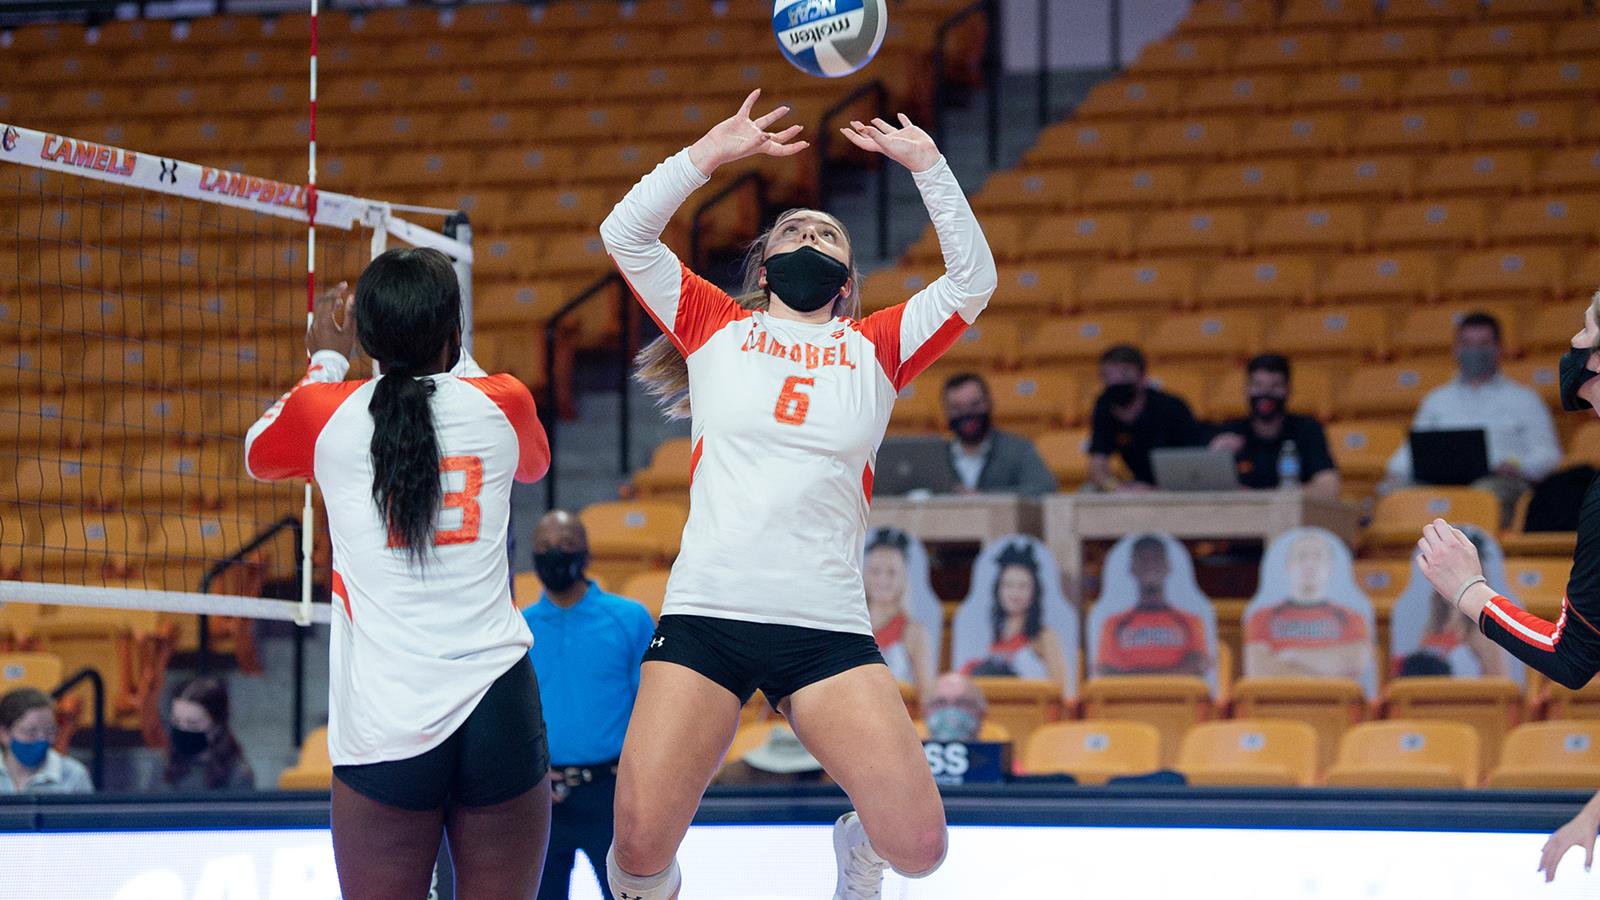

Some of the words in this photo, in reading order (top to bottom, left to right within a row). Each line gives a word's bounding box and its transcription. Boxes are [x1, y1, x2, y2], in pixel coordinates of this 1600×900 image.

[789, 17, 851, 44] molten
[40, 133, 137, 177] CAMELS
[774, 375, 815, 427] 6
